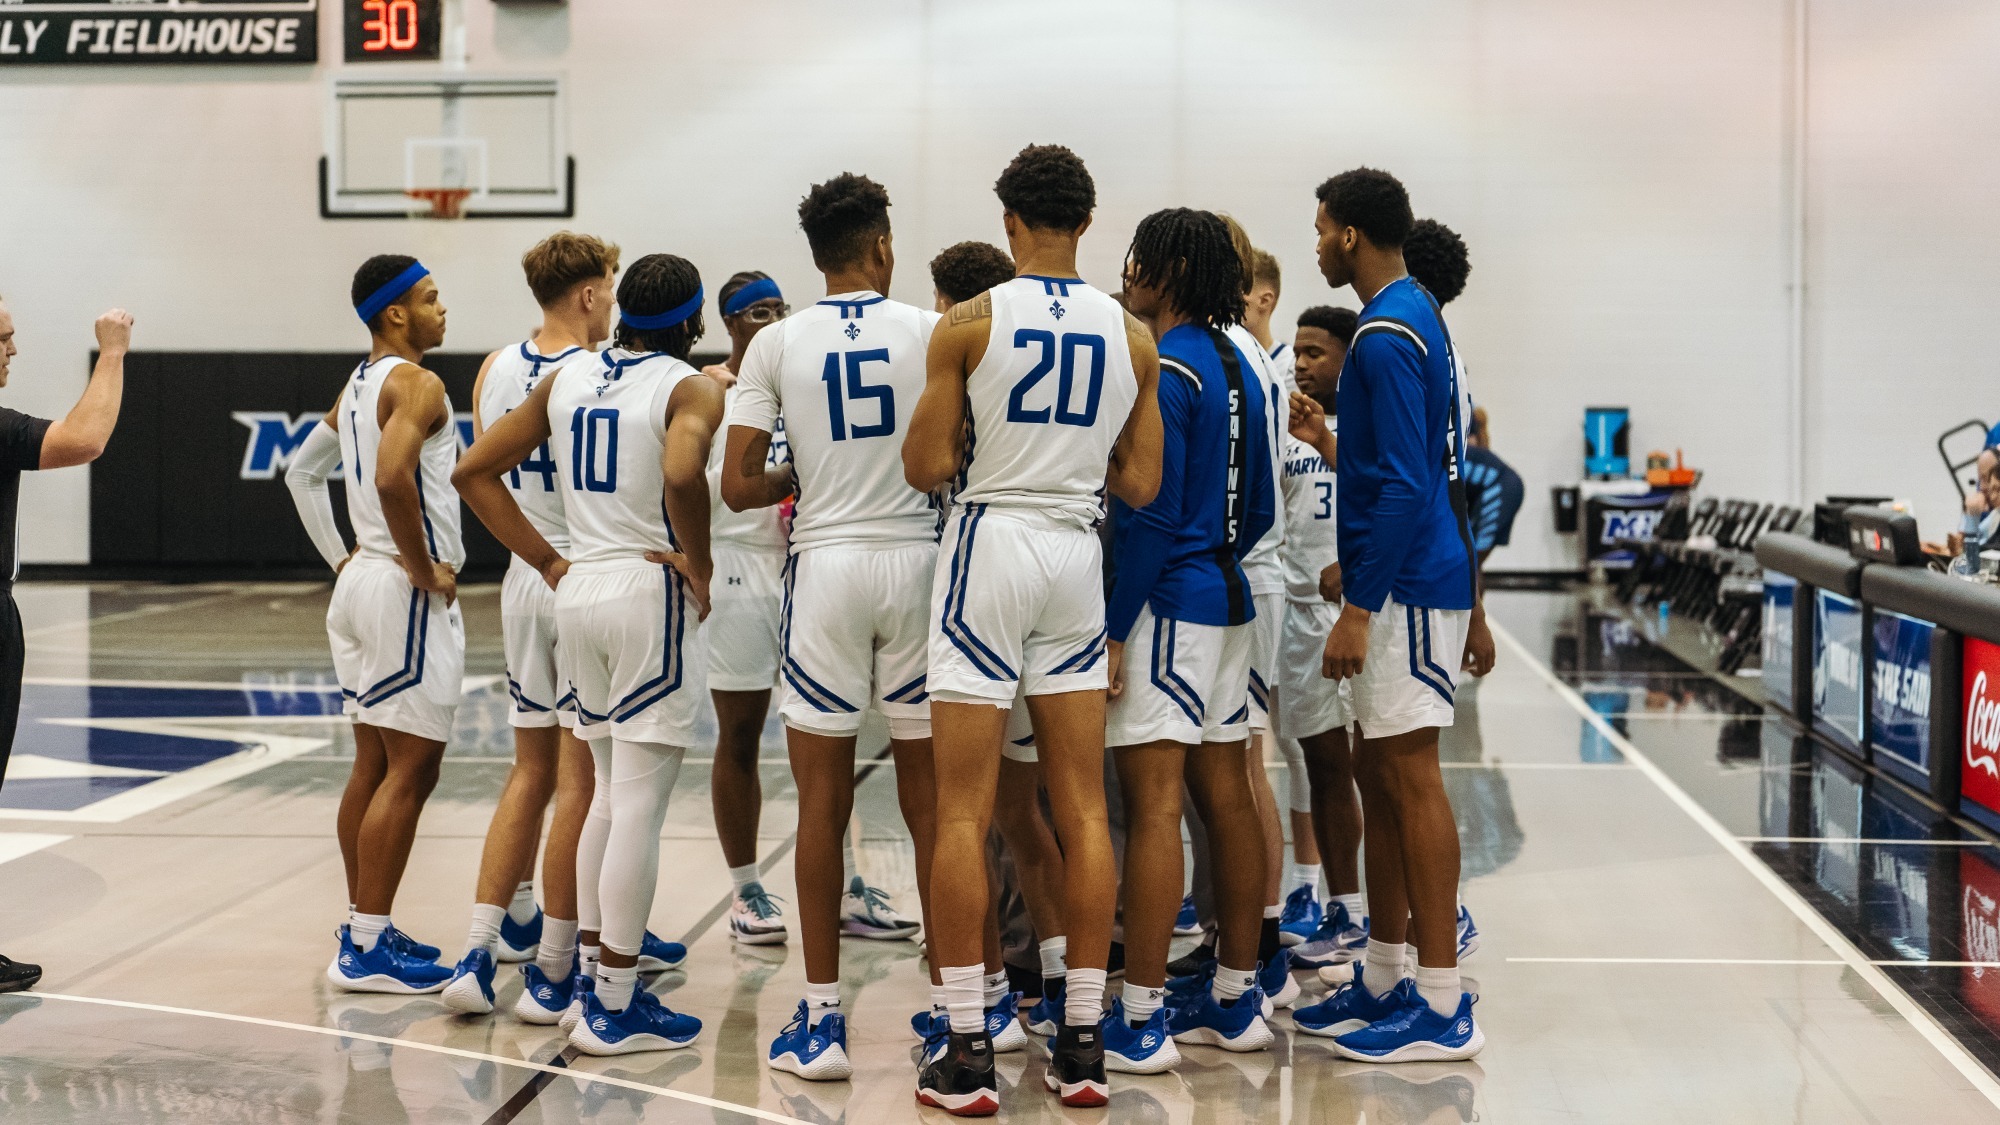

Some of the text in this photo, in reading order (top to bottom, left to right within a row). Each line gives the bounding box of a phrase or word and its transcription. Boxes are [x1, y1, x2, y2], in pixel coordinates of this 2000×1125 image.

[66, 18, 300, 54] FIELDHOUSE
[363, 0, 417, 50] 30
[822, 347, 896, 441] 15
[1006, 328, 1106, 427] 20
[570, 406, 620, 493] 10
[1227, 389, 1240, 543] SAINTS
